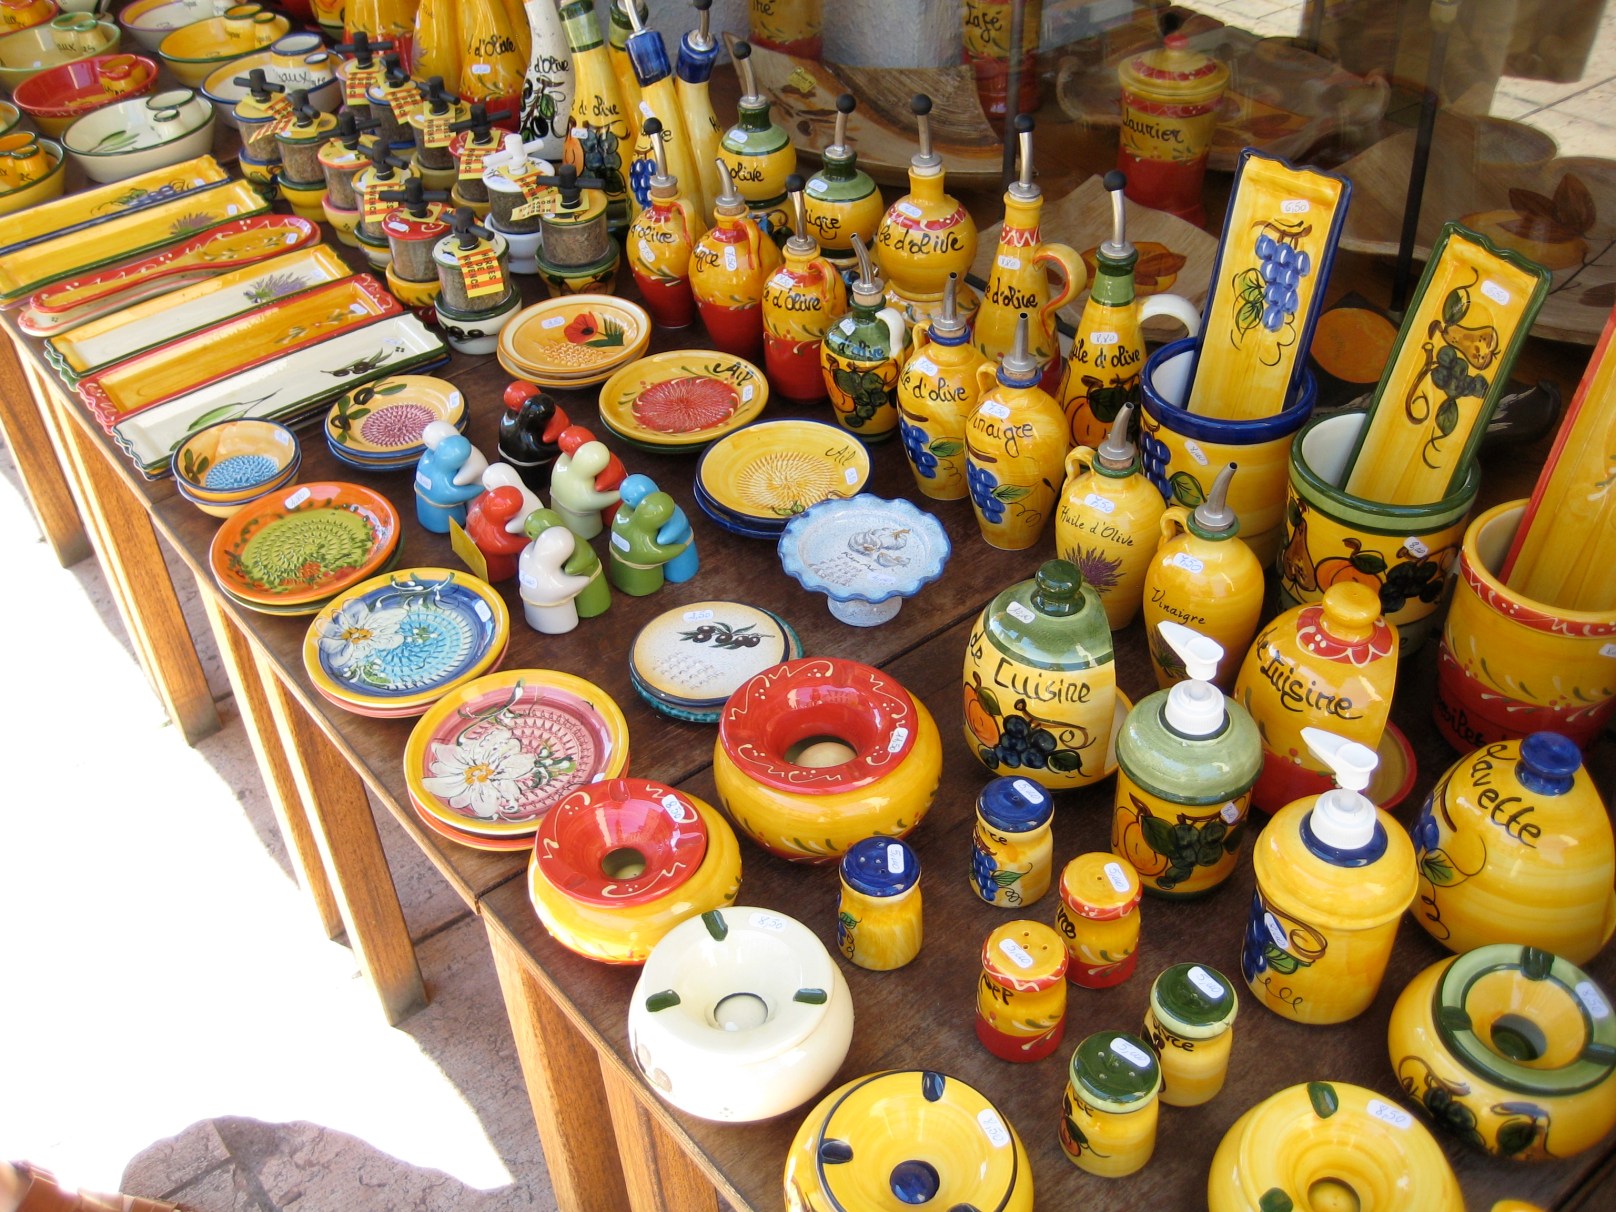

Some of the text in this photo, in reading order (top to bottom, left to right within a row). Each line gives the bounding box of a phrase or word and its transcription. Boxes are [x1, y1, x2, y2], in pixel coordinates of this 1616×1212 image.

[1061, 504, 1085, 530] Huile
[1152, 586, 1206, 626] Vinaigre
[993, 656, 1091, 704] Cuisine
[1375, 1104, 1407, 1123] 8,50
